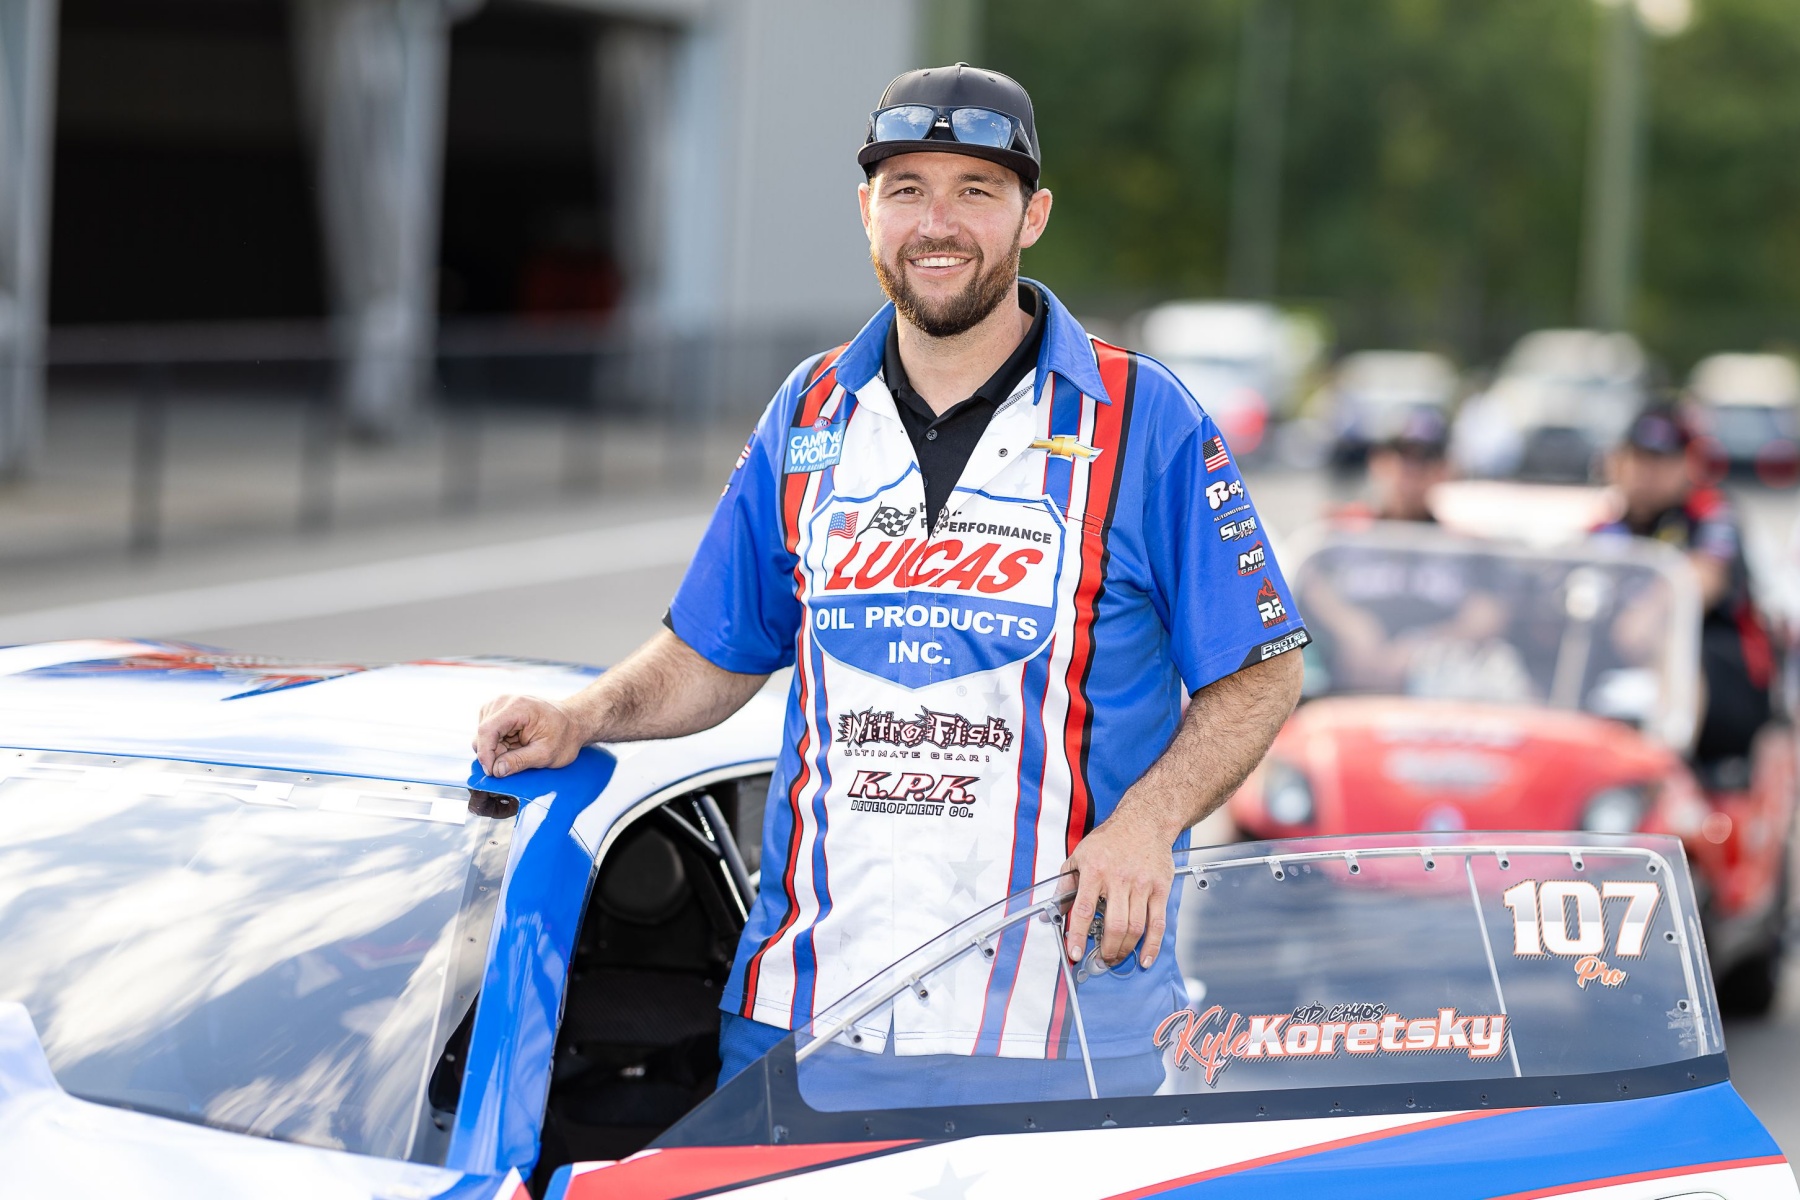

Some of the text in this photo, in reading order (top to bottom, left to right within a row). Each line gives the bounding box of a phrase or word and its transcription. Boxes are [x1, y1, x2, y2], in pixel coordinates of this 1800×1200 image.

[825, 537, 1044, 594] LUCAS
[816, 604, 1039, 641] OIL PRODUCTS
[888, 641, 951, 665] INC.
[844, 749, 921, 759] ULTIMATE
[851, 799, 974, 818] DEVELOPMENT CO.
[1503, 879, 1662, 958] 107
[1574, 955, 1627, 990] Pro
[1289, 1001, 1386, 1024] KID CHAOS
[1152, 1004, 1507, 1086] Kyle Koretsky
